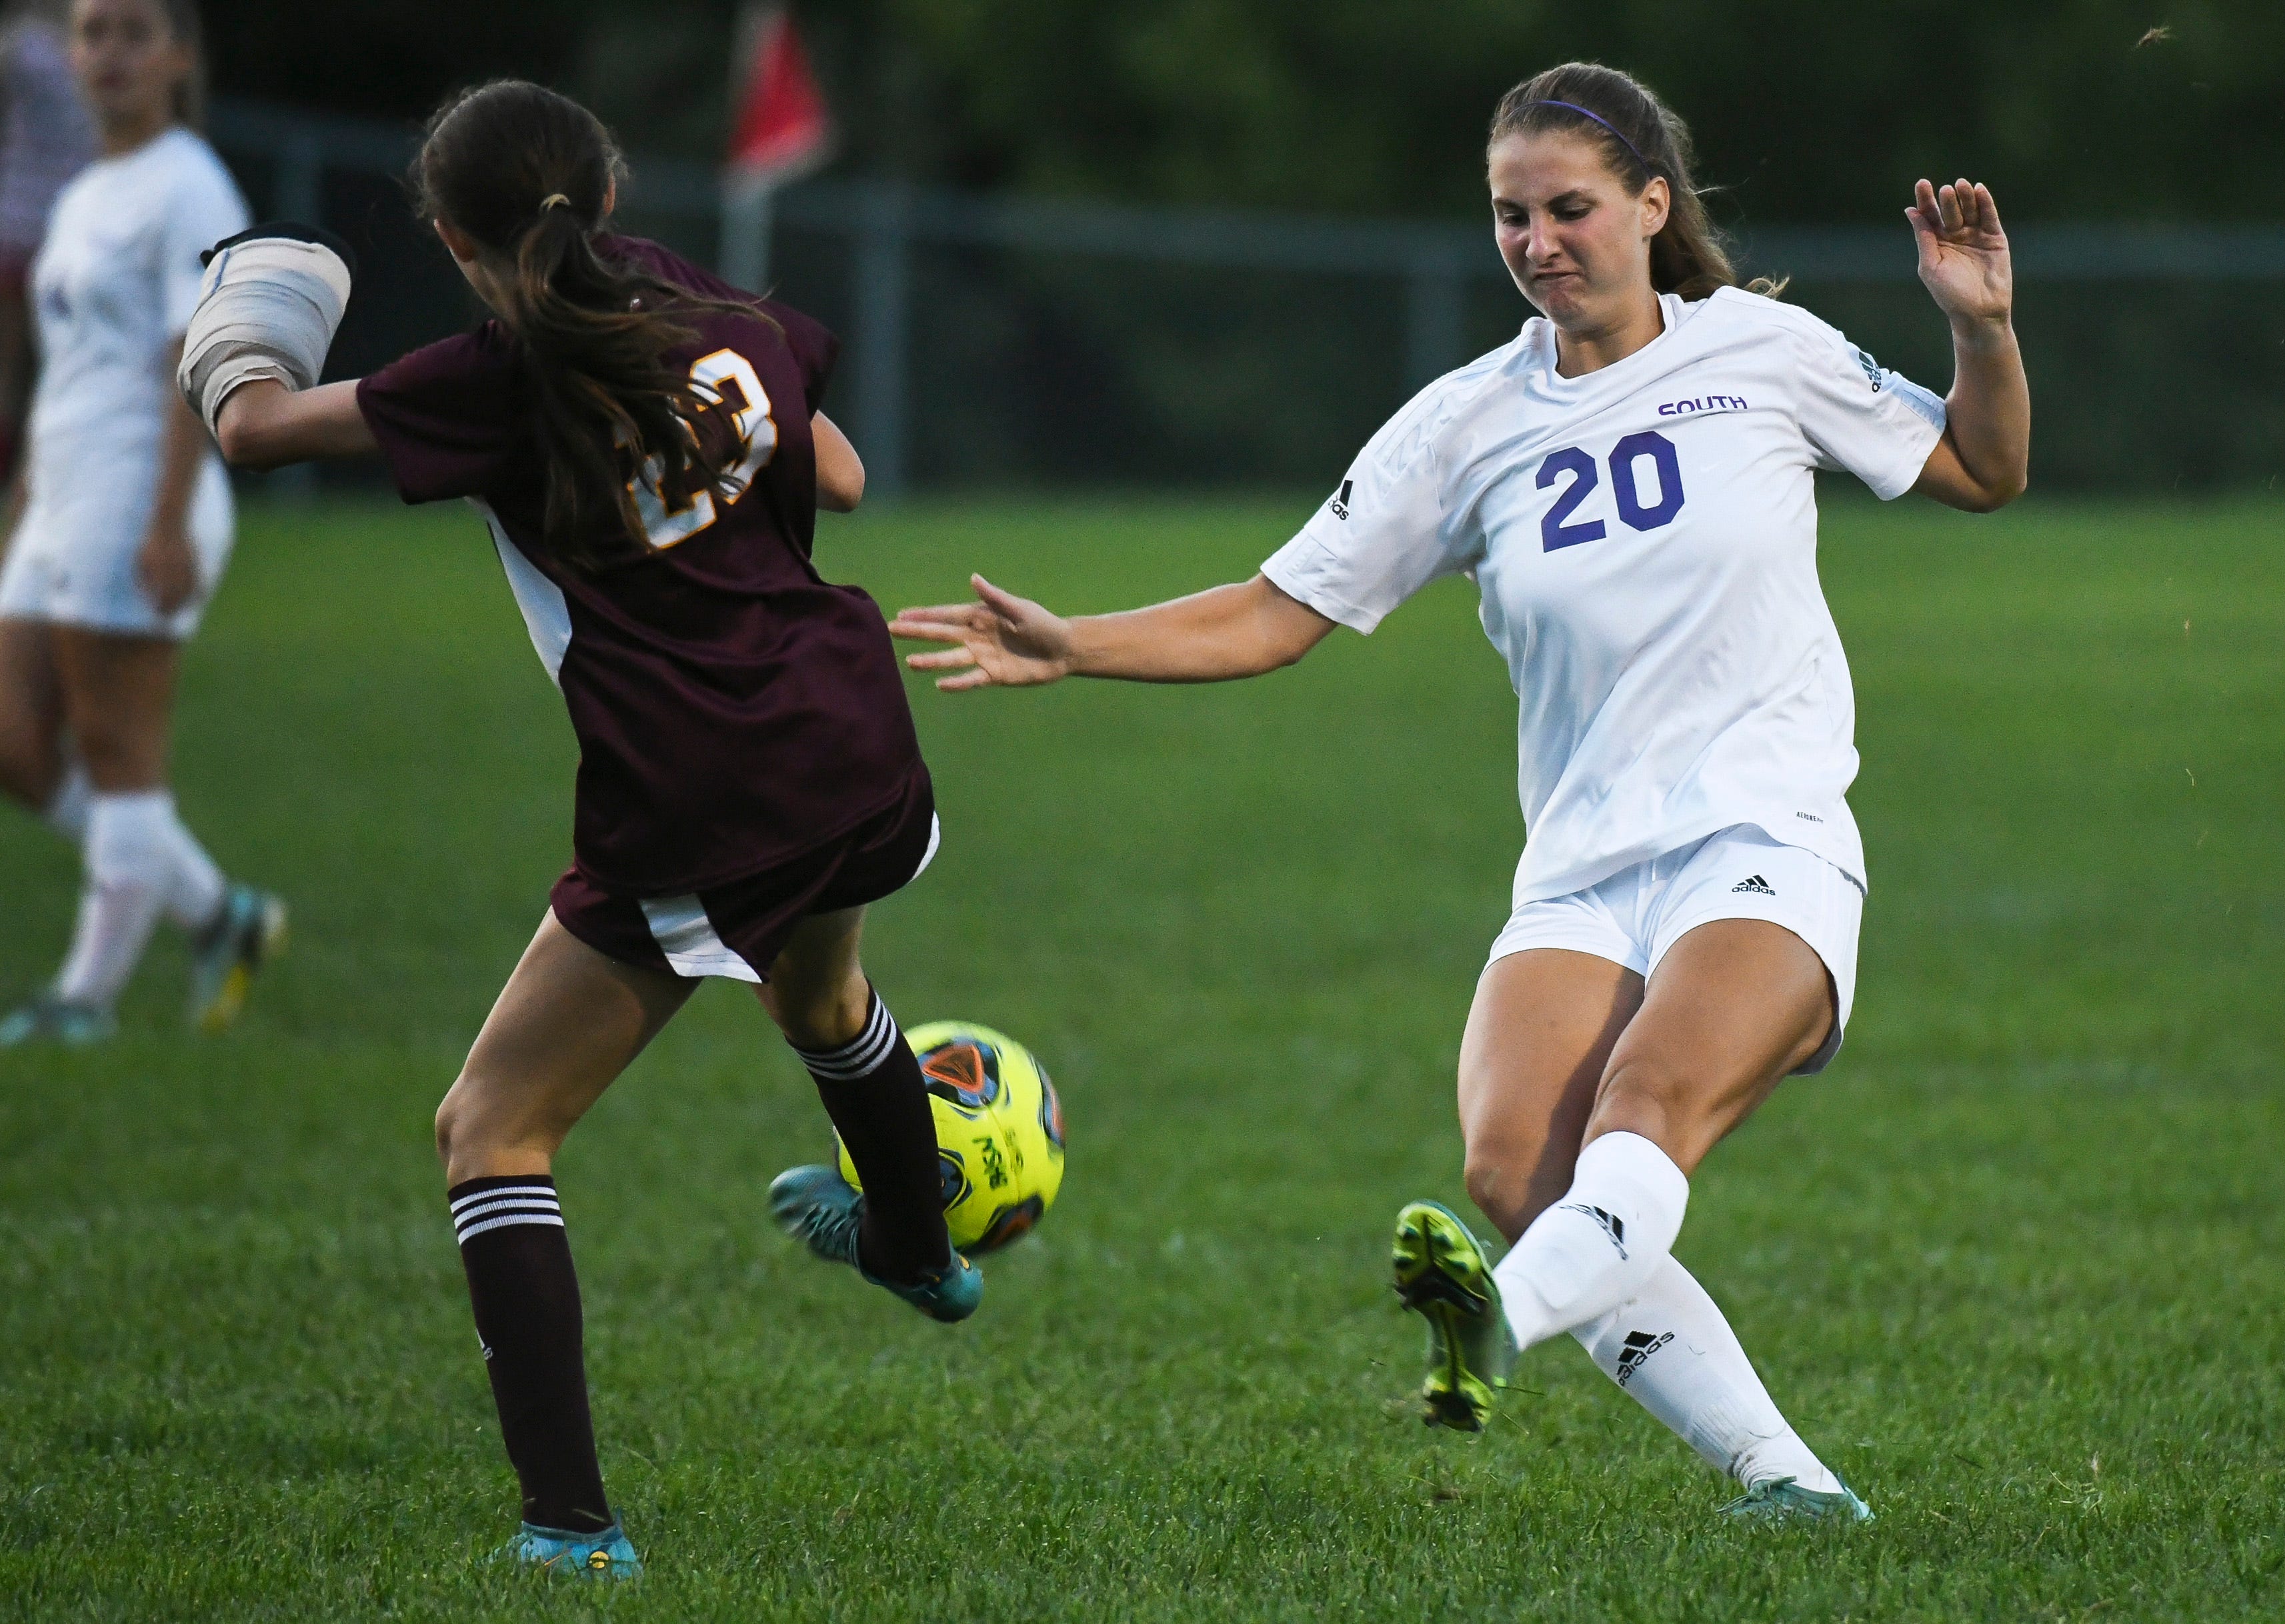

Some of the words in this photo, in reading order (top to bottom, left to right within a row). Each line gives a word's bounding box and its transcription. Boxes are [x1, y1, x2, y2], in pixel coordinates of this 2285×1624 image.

[1658, 395, 1748, 416] SOUTH
[1536, 430, 1685, 553] 20
[1732, 884, 1776, 896] adidas
[1618, 1331, 1676, 1387] adidas
